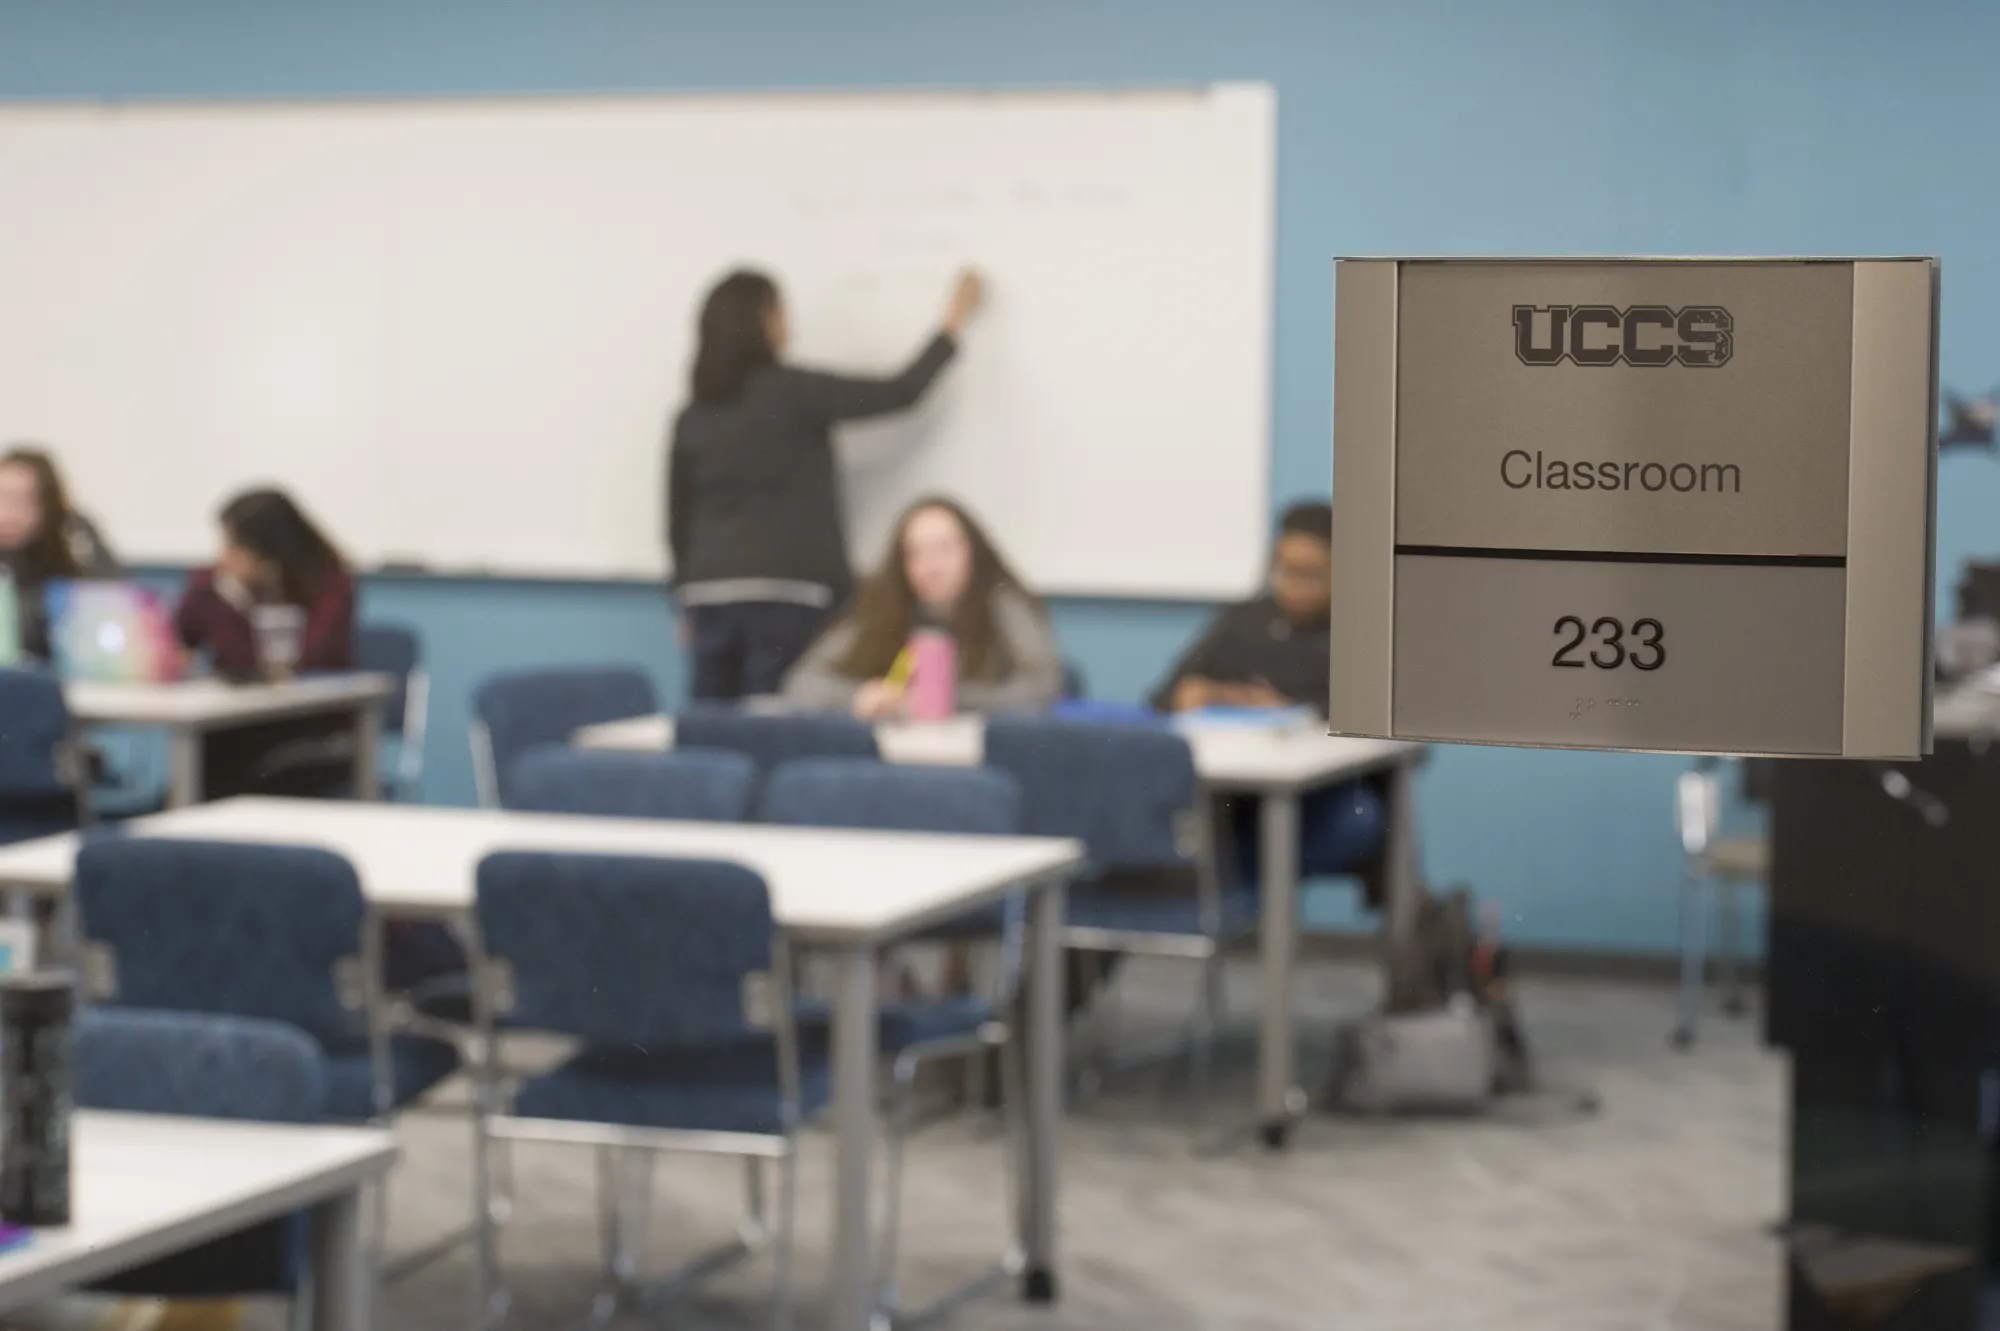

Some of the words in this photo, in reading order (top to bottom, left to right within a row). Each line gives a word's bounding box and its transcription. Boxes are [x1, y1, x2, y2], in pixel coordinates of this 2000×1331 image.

[1512, 304, 1734, 368] UCCS
[1500, 449, 1740, 493] Classroom
[1552, 615, 1667, 671] 233
